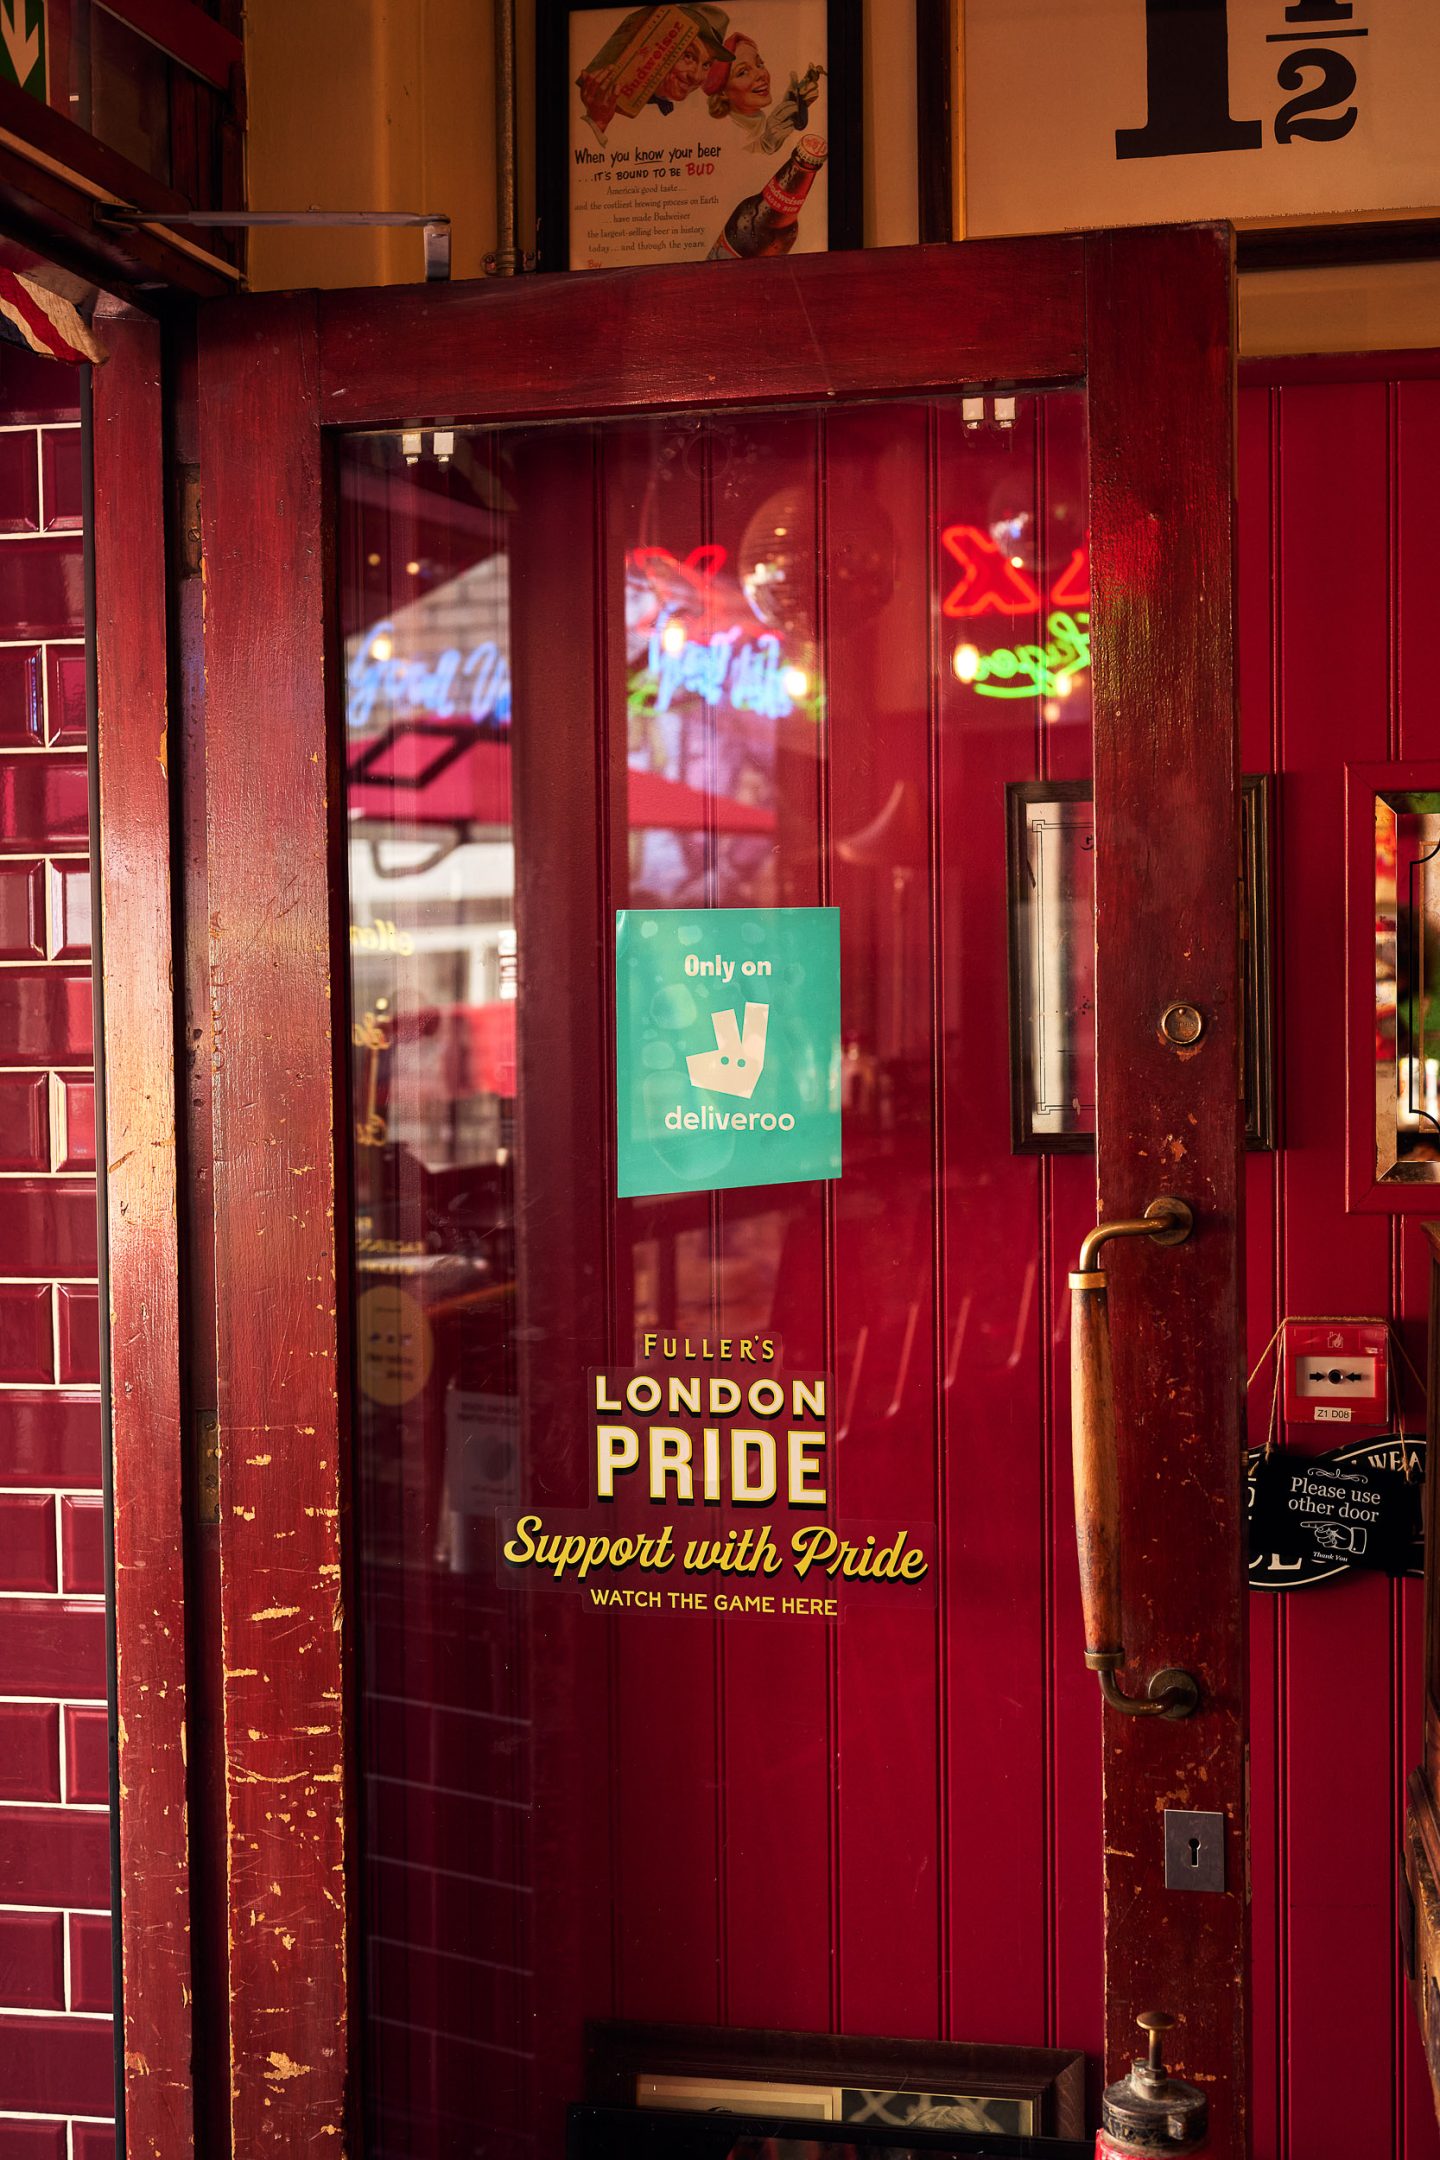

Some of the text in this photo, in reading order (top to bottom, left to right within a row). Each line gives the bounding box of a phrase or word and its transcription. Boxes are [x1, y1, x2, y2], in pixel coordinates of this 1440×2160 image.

[620, 21, 681, 97] Budweiser
[574, 142, 721, 168] When you know your beer
[616, 169, 649, 181] BOUND
[652, 168, 666, 178] TO
[669, 167, 681, 177] BE
[685, 162, 715, 176] BUD
[574, 201, 588, 211] and
[590, 200, 602, 210] the
[700, 195, 720, 205] Earth
[640, 185, 658, 195] good
[631, 213, 651, 222] made
[654, 212, 690, 221] Budweiser
[587, 230, 599, 239] the
[653, 226, 669, 236] beer
[671, 227, 679, 235] in
[620, 242, 635, 251] and
[637, 241, 667, 251] through
[669, 240, 682, 249] the
[684, 954, 772, 984] Only on
[665, 1105, 796, 1131] deliveroo
[644, 1333, 775, 1361] FULLER'S
[595, 1375, 826, 1418] LONDON
[1317, 1409, 1350, 1419] Z1 D08
[596, 1425, 827, 1506] PRIDE
[1290, 1476, 1381, 1505] Please use
[1288, 1496, 1380, 1523] other door
[503, 1515, 929, 1581] Support with Pride
[1313, 1551, 1349, 1563] Thank You
[590, 1589, 838, 1617] WATCH THE GAME HERE
